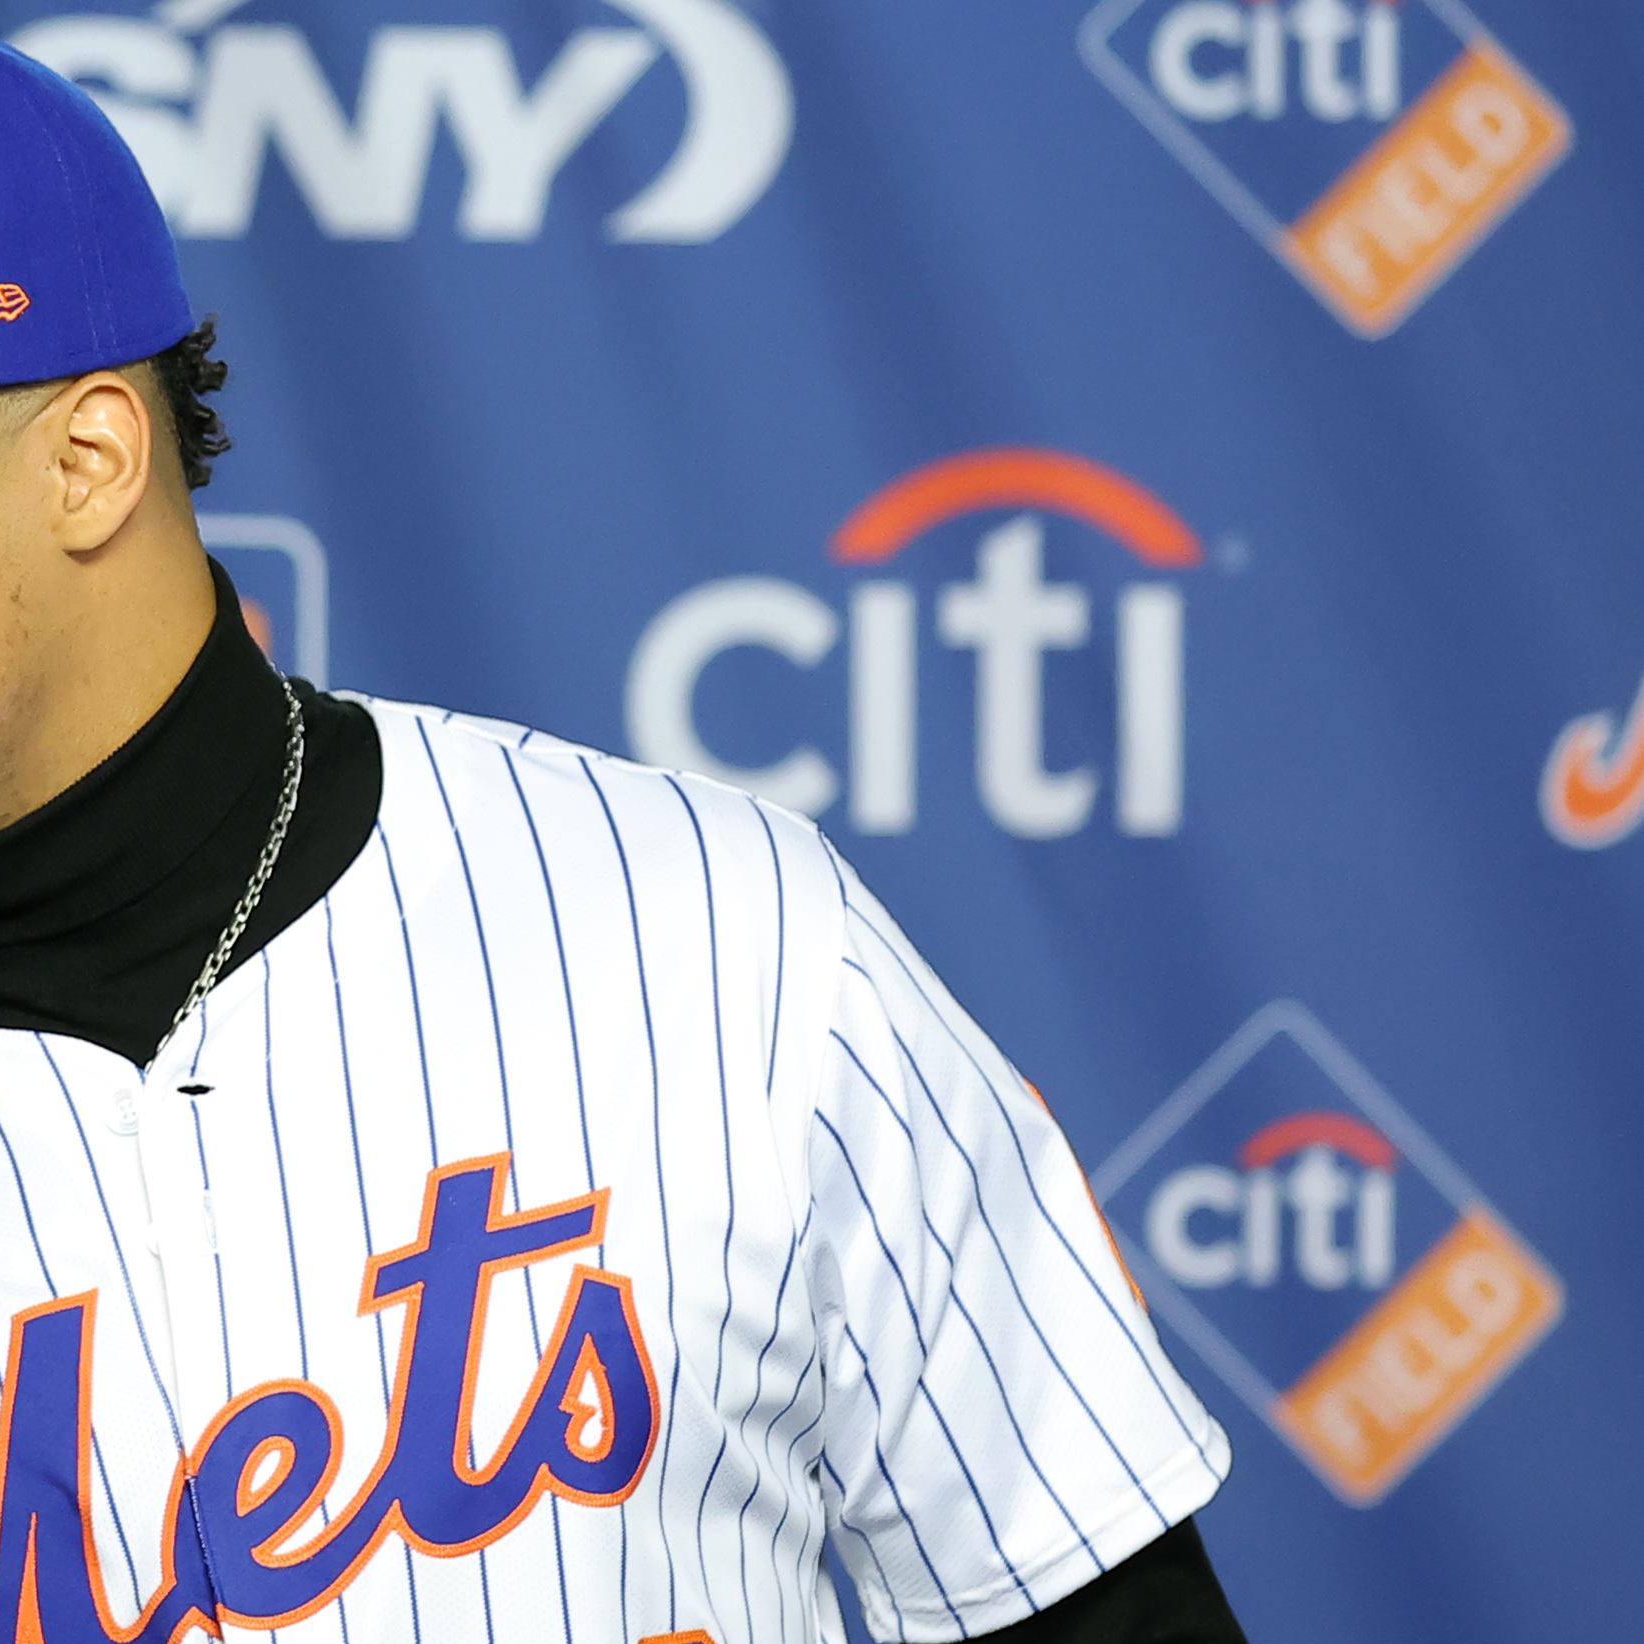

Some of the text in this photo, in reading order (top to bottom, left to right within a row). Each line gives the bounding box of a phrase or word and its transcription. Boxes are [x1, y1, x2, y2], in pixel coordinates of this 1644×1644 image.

[1148, 0, 1403, 122] citi
[623, 508, 1187, 840] citi
[1145, 1143, 1398, 1290] citi
